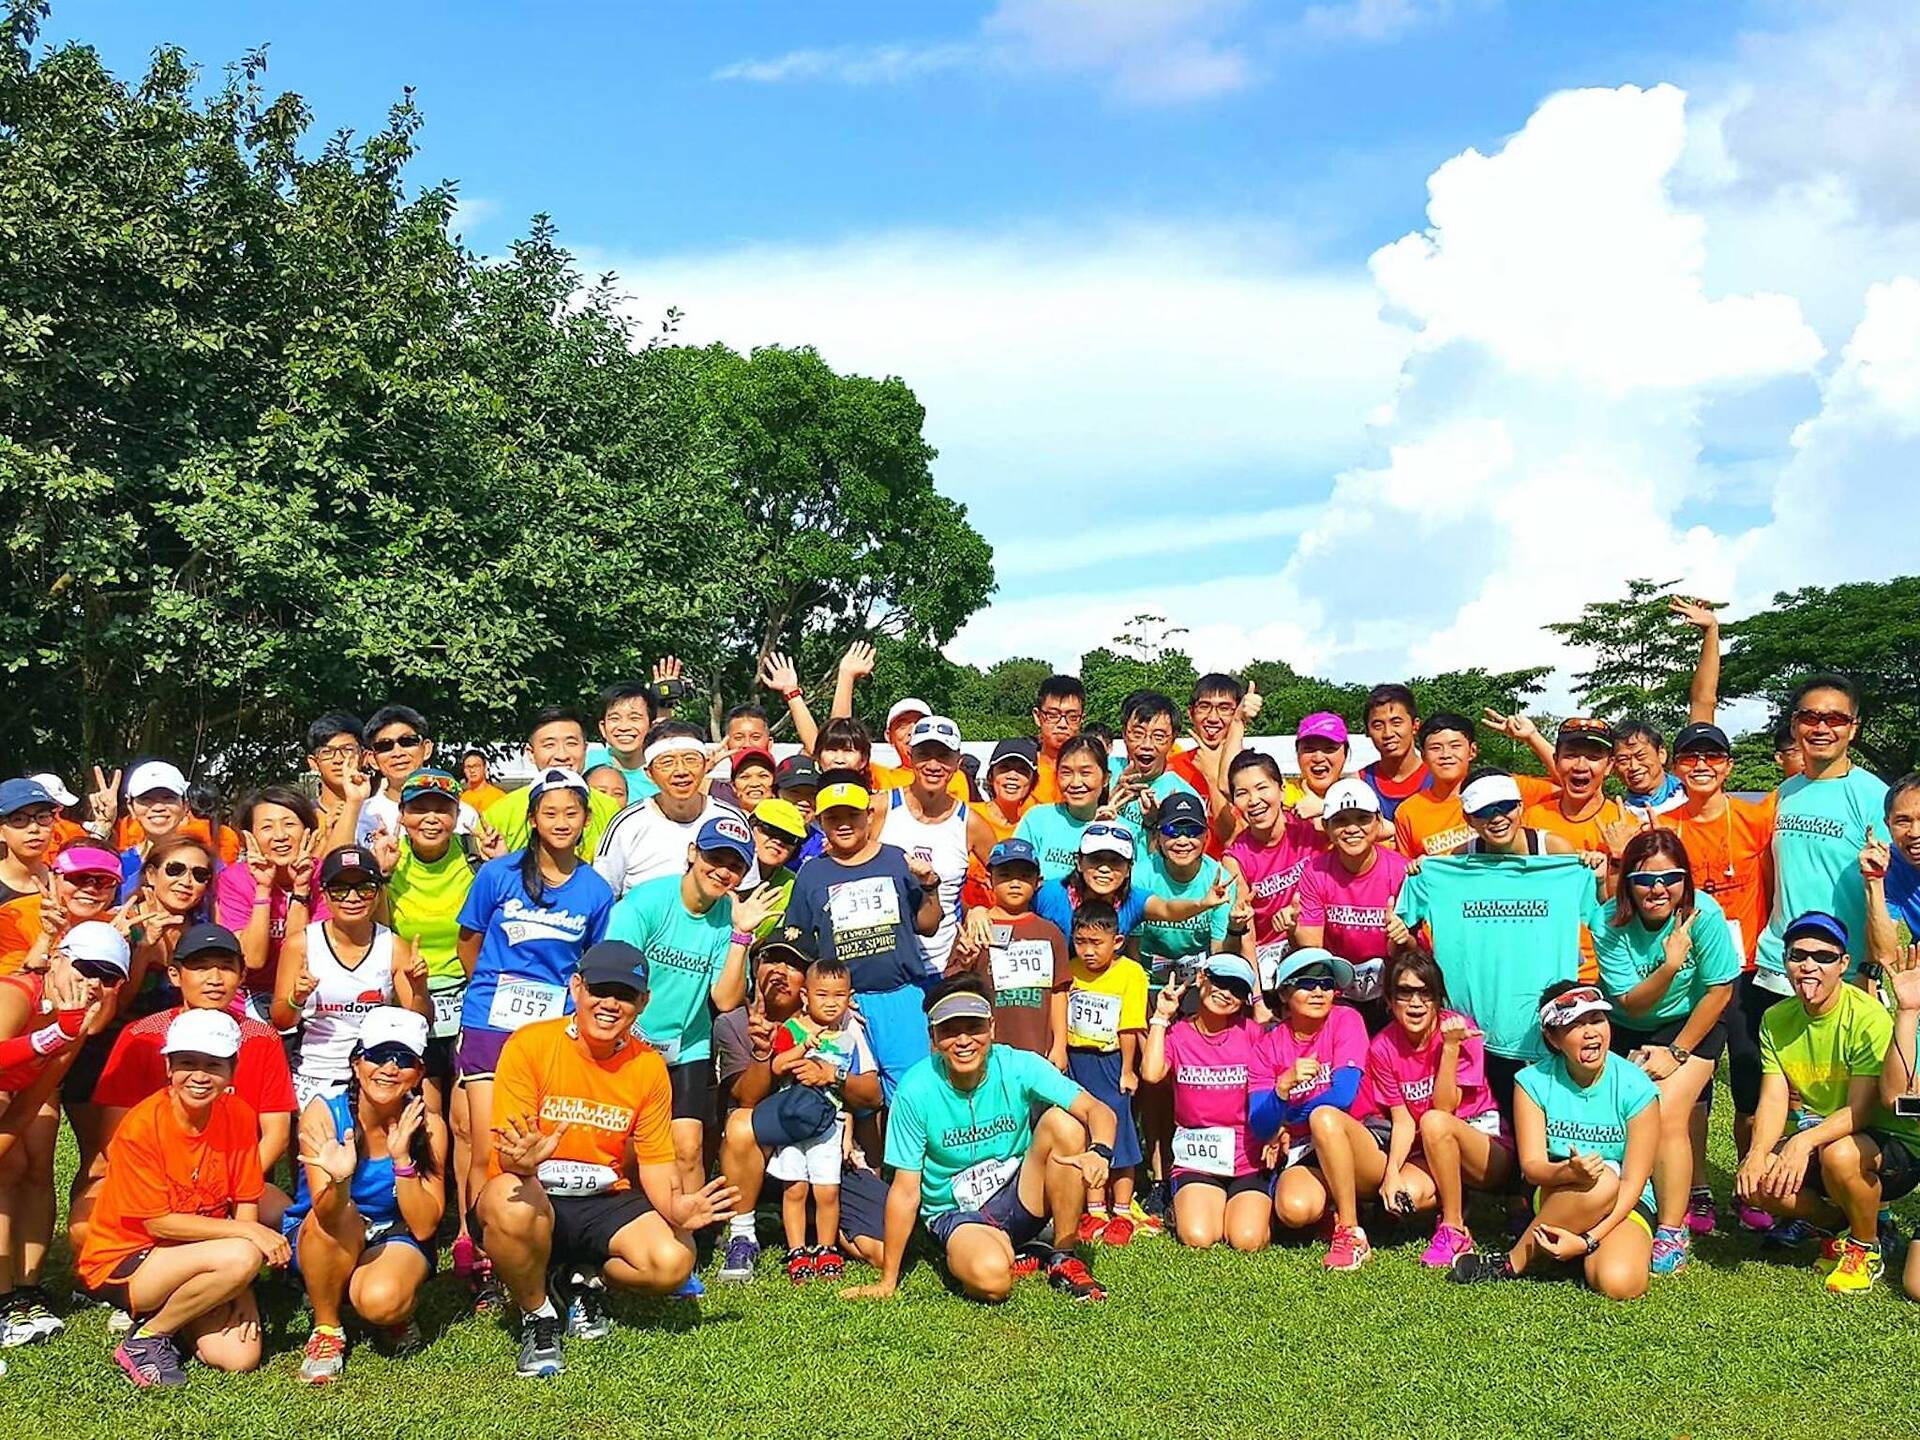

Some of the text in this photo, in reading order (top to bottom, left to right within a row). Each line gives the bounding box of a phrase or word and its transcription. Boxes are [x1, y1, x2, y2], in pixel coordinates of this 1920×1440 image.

[849, 895, 882, 913] 393
[1009, 957, 1041, 973] 390
[510, 998, 547, 1017] 057
[1076, 1005, 1102, 1025] 391
[1187, 1143, 1218, 1159] 080
[559, 1175, 597, 1190] 138
